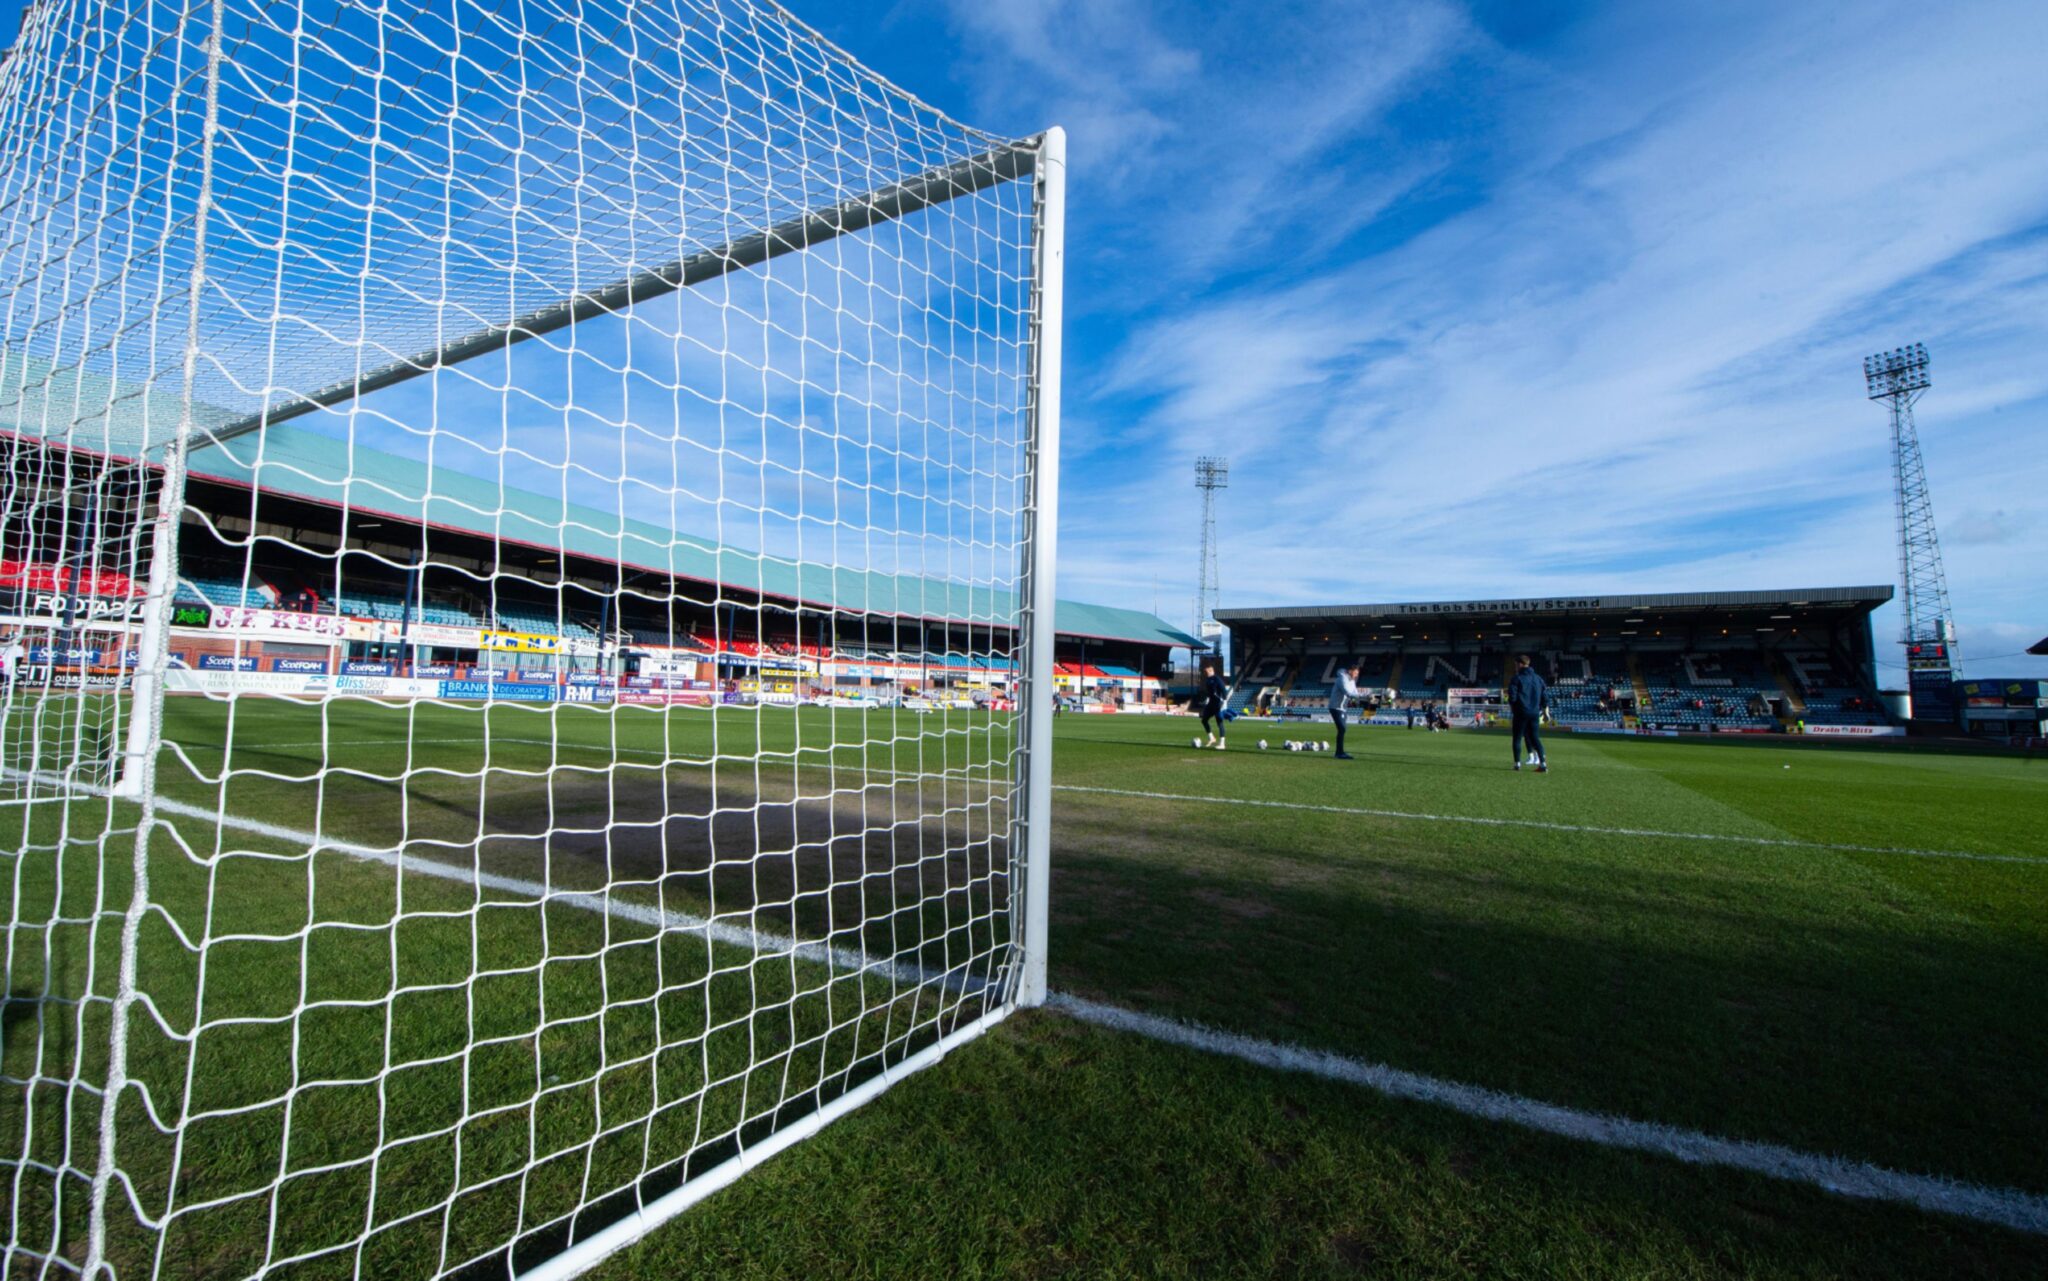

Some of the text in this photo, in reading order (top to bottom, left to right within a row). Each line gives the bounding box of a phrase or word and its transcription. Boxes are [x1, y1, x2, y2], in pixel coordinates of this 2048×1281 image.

[1399, 599, 1600, 613] The Bob Shankly Stand
[447, 682, 501, 693] BRANKN
